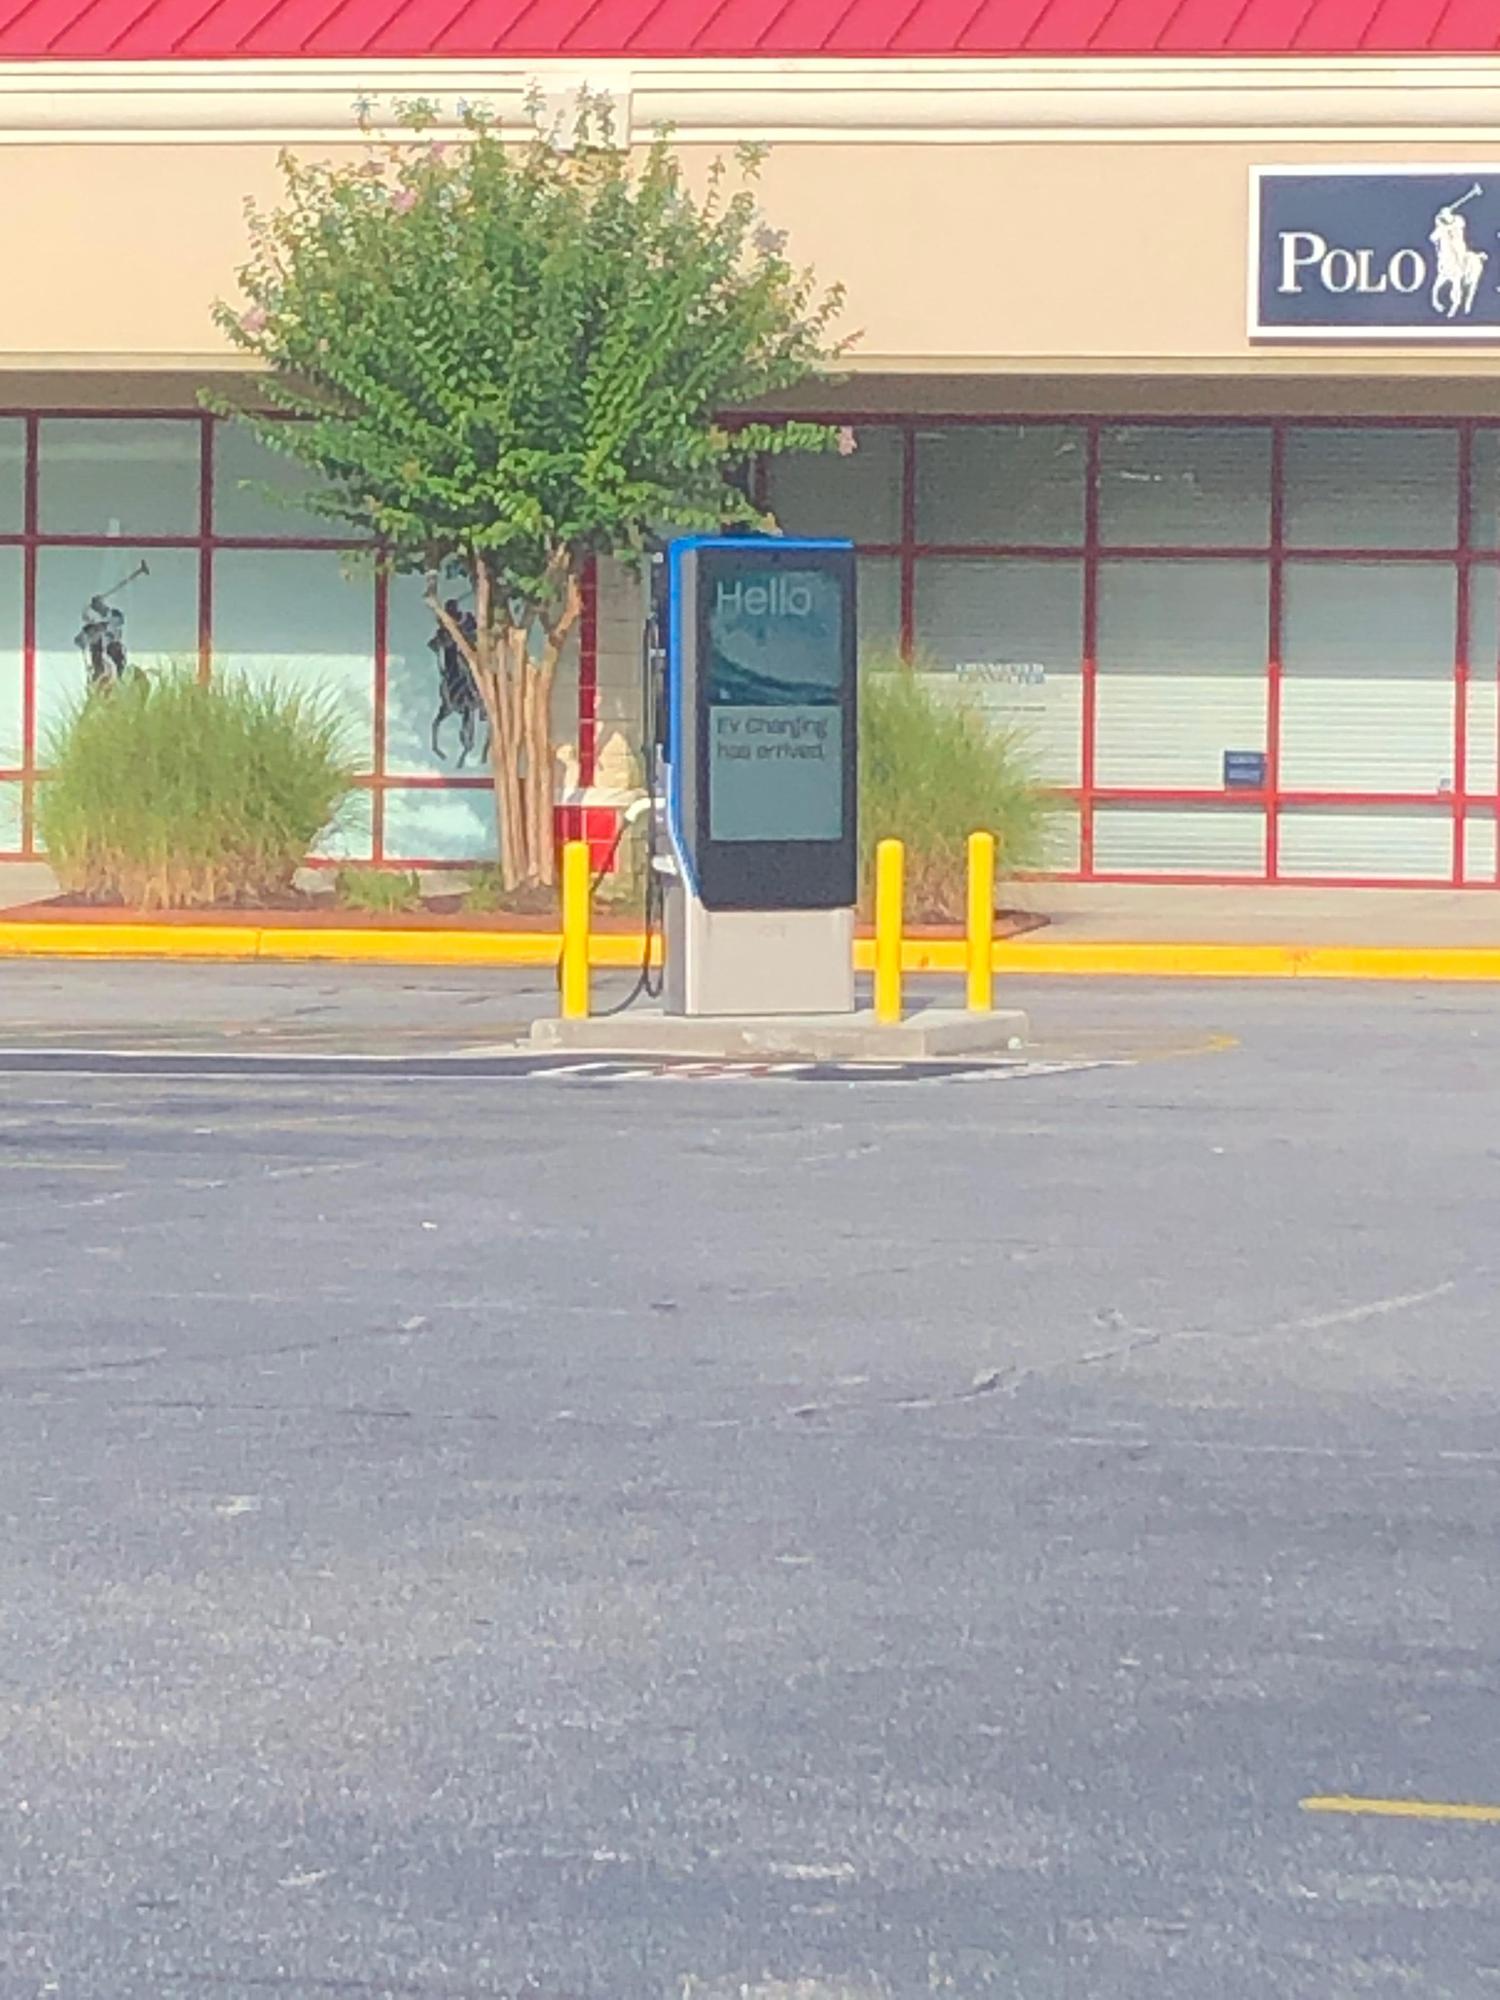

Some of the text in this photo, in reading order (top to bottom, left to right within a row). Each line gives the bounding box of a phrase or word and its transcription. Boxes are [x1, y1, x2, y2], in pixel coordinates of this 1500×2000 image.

[1277, 231, 1426, 293] POLO
[717, 577, 811, 616] Hello
[717, 741, 751, 759] has
